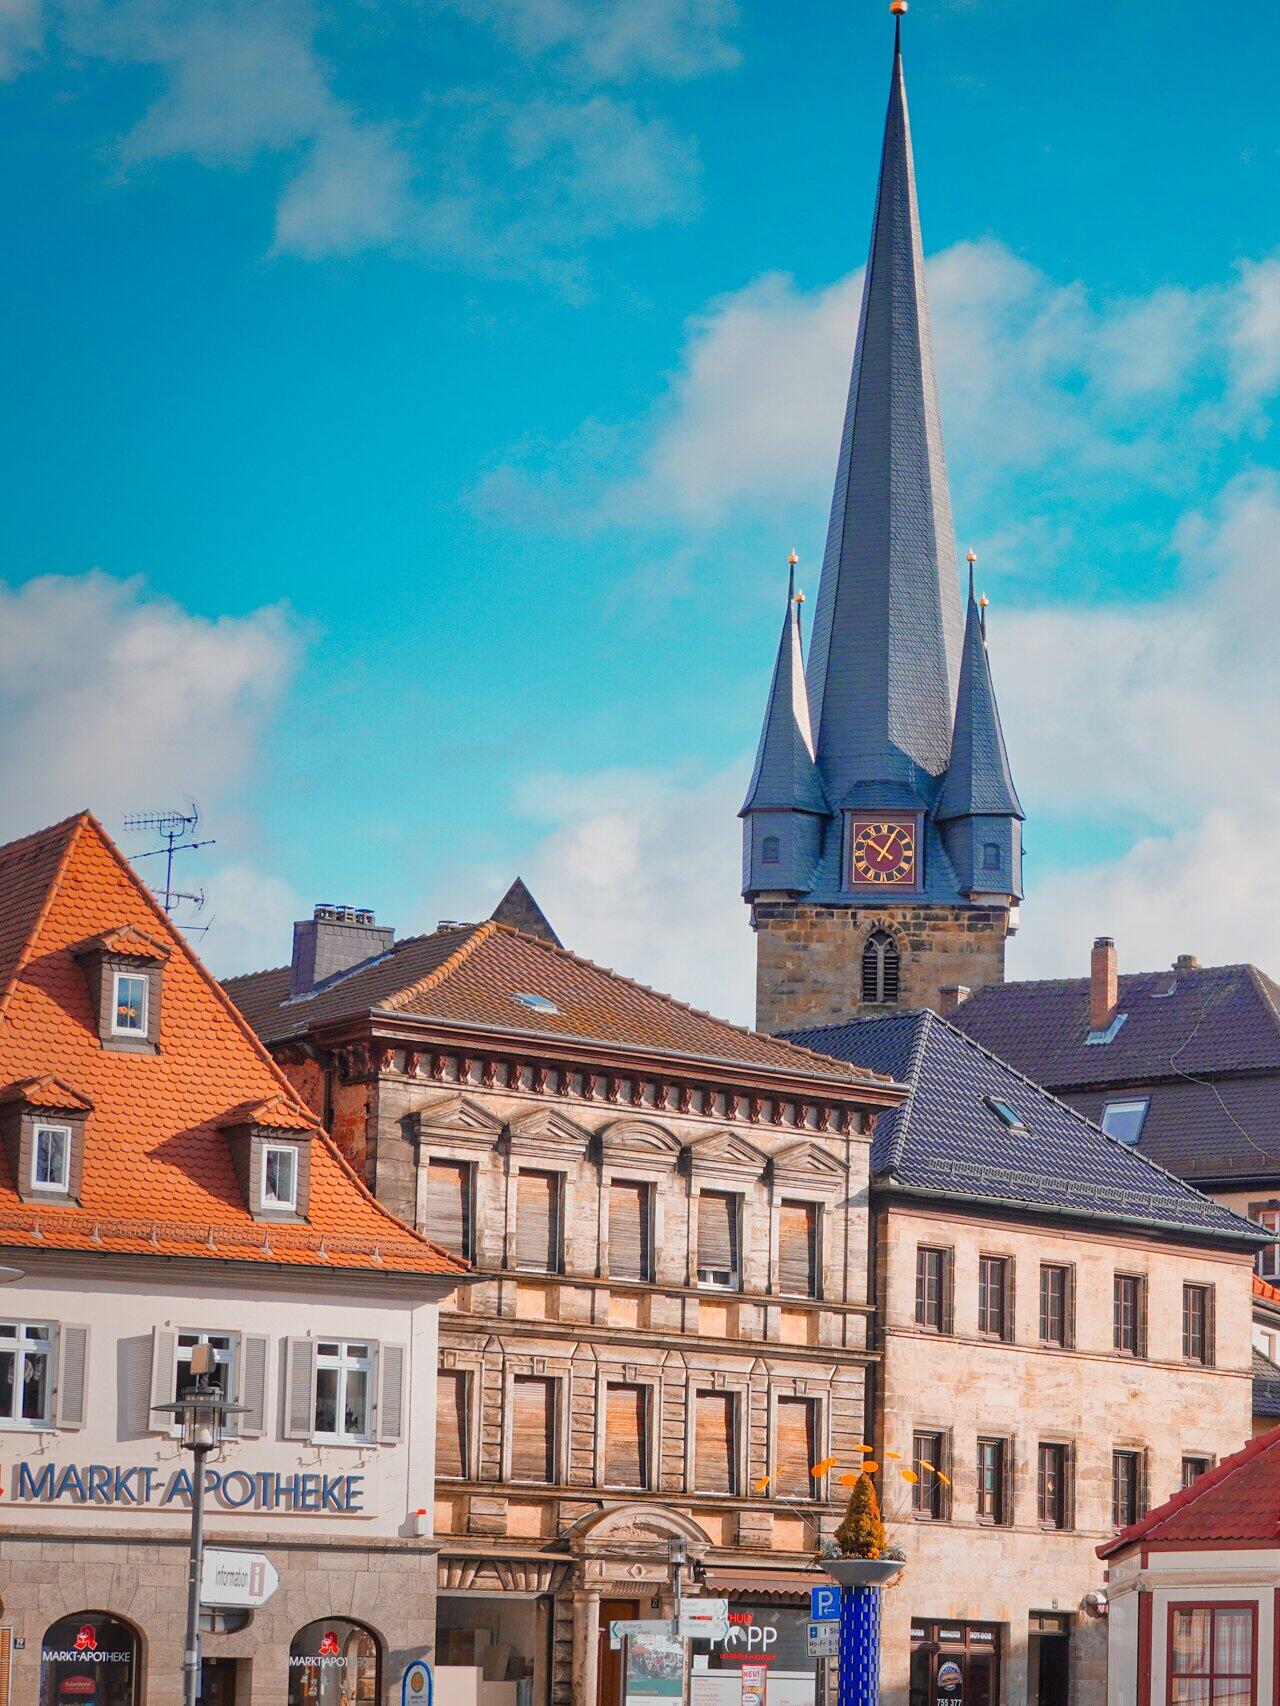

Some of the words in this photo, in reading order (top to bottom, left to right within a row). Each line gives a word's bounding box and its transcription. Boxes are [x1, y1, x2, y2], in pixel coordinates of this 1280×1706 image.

[19, 1461, 364, 1511] MARKT-APOTHEKE
[215, 1564, 248, 1588] Information
[818, 1590, 834, 1616] P
[42, 1651, 131, 1662] MARKT-APOTHEKE
